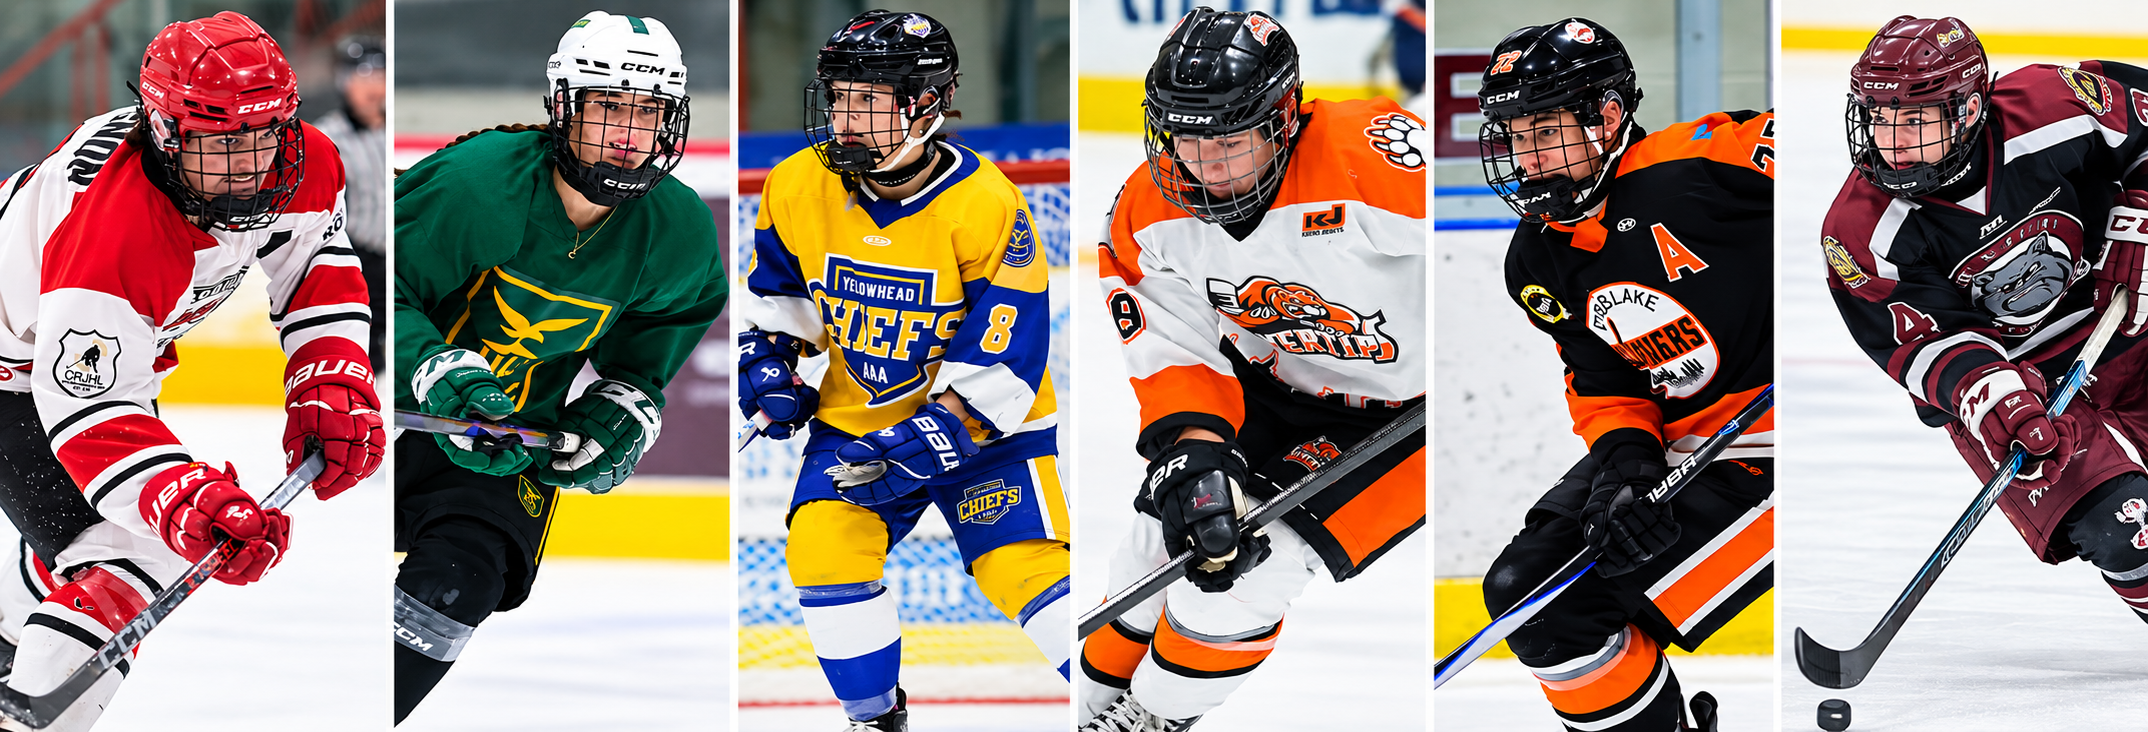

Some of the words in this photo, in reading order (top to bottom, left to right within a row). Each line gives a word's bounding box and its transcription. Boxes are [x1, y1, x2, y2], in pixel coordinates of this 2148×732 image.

[621, 62, 665, 75] CCM
[1863, 81, 1899, 90] CCM
[237, 98, 282, 114] CCM
[1486, 90, 1520, 104] CCM
[1168, 113, 1213, 124] CCM
[1650, 223, 1709, 282] A
[979, 304, 1018, 355] 8
[1888, 302, 1940, 345] 4
[65, 370, 104, 386] CRJHL
[863, 362, 888, 384] AAA
[960, 488, 1019, 521] CHIEFS
[99, 608, 157, 662] CCM
